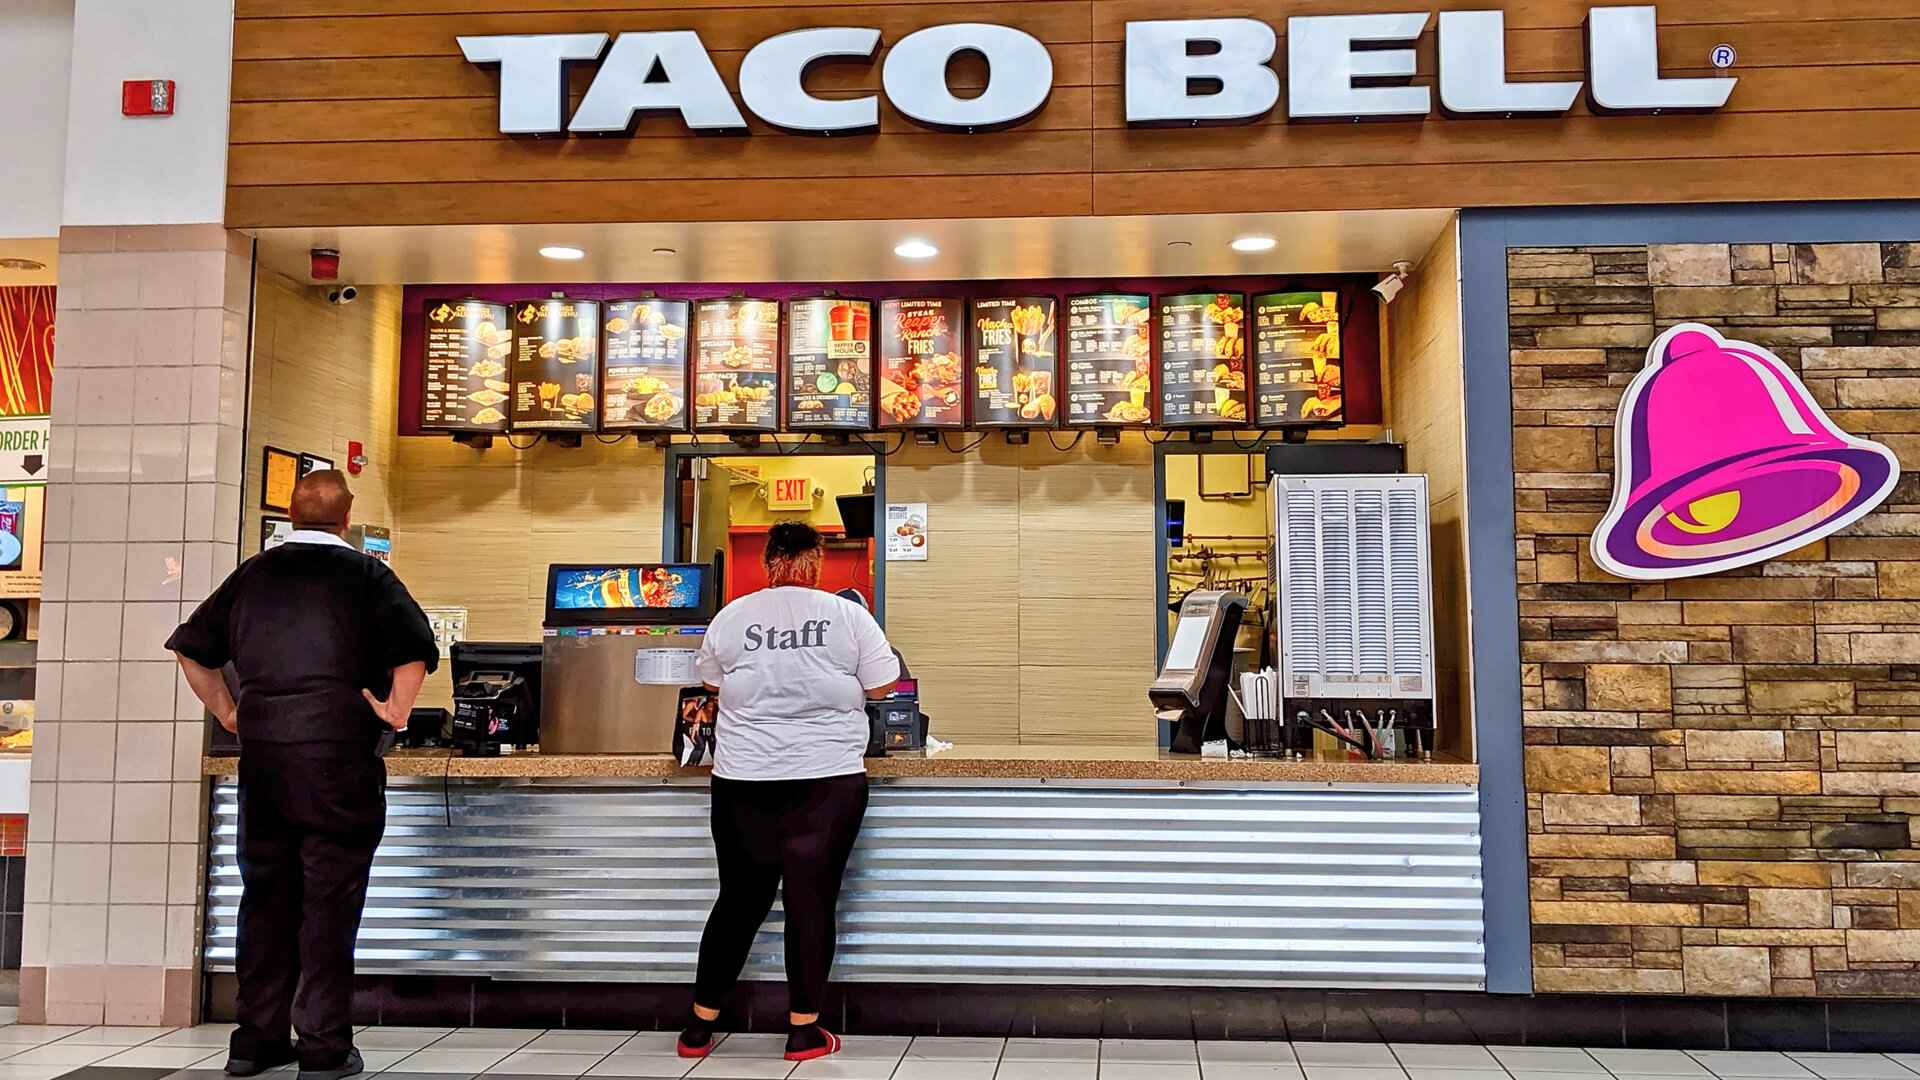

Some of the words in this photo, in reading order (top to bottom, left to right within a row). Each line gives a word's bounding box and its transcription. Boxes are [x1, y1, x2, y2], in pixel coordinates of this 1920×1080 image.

[456, 23, 1053, 133] TACO
[1126, 5, 1738, 122] BELL
[895, 312, 945, 330] Reaper
[907, 309, 935, 318] STEAK
[983, 328, 1012, 346] FRIES
[907, 339, 935, 355] FRIES
[776, 479, 806, 501] EXIT
[744, 619, 831, 652] Staff
